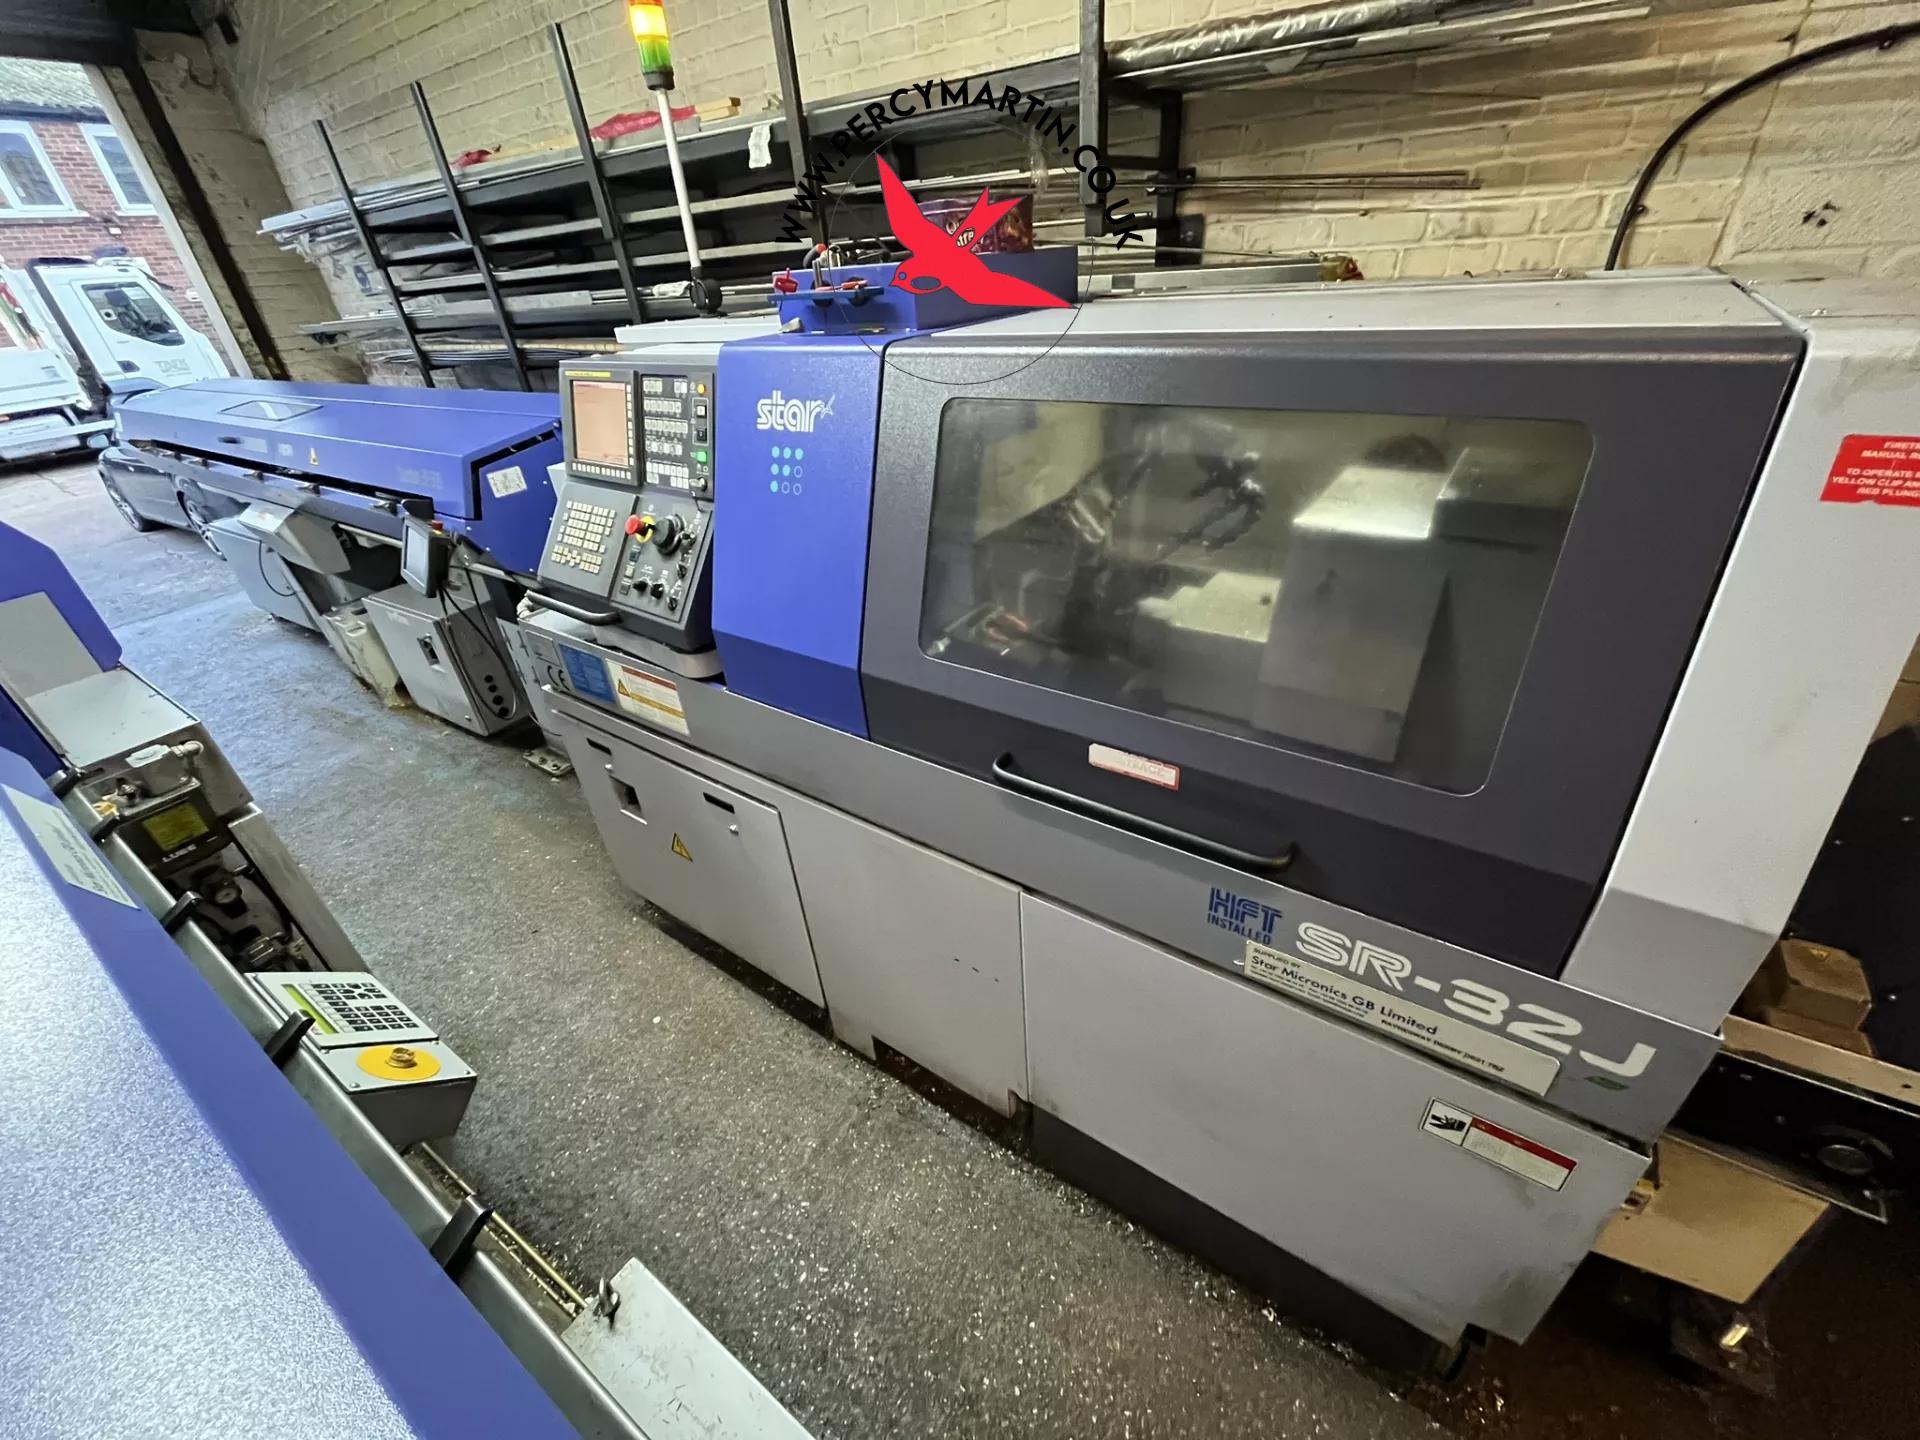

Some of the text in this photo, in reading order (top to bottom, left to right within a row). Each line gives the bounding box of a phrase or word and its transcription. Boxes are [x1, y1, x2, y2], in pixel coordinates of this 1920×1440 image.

[757, 389, 826, 432] star
[1860, 449, 1907, 459] MANUAL
[1832, 476, 1877, 486] YELLOW
[1876, 478, 1904, 487] CLIP
[1846, 467, 1861, 476] TO
[1861, 468, 1914, 479] OPERATE
[1207, 913, 1272, 945] INSTALLED
[1251, 955, 1278, 971] Star
[1281, 967, 1348, 1000] Micronics
[1352, 995, 1375, 1010] GB
[1380, 1006, 1438, 1035] Limited
[1296, 922, 1657, 1077] SR-32J
